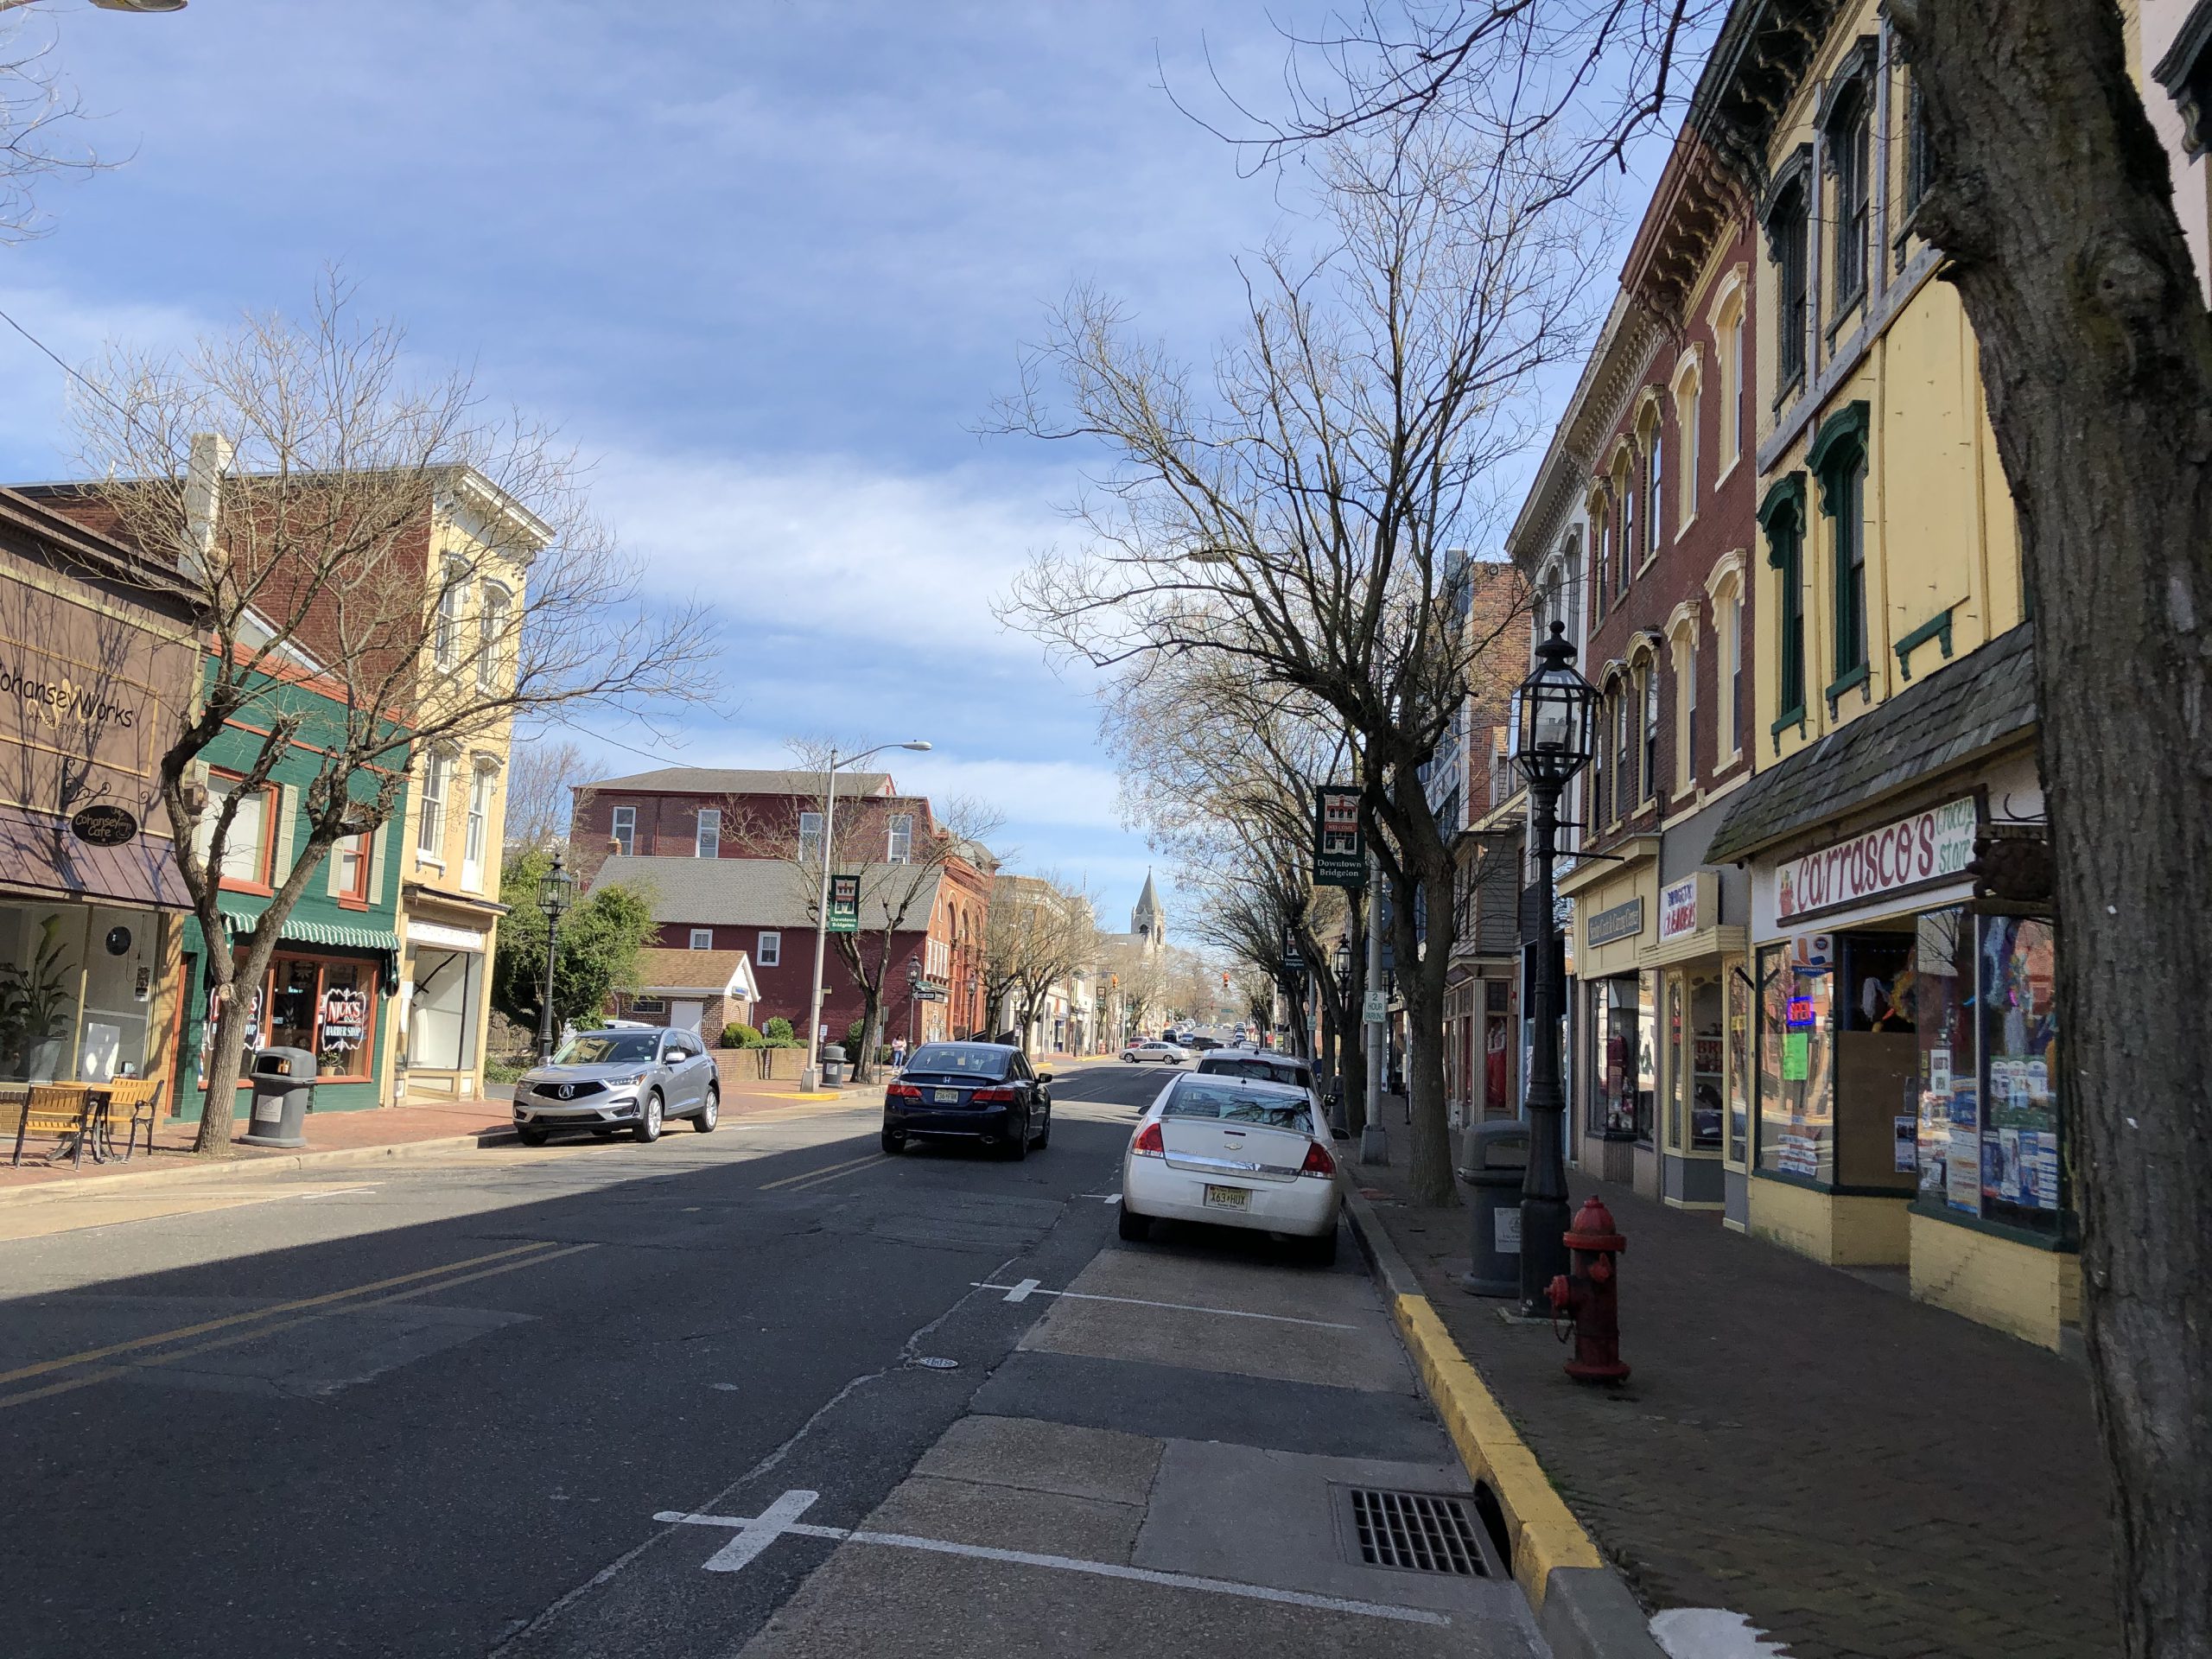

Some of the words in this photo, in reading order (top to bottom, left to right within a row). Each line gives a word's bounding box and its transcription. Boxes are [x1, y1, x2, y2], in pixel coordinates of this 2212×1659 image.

[75, 814, 120, 830] Cohansey
[1317, 859, 1362, 868] Downtown
[1319, 868, 1359, 878] Bridgeton
[1368, 1002, 1382, 1011] HOUR
[327, 1001, 360, 1024] NICK'S
[1365, 1012, 1384, 1020] PARKING
[325, 1025, 346, 1037] BARBER
[346, 1026, 361, 1037] SHOP
